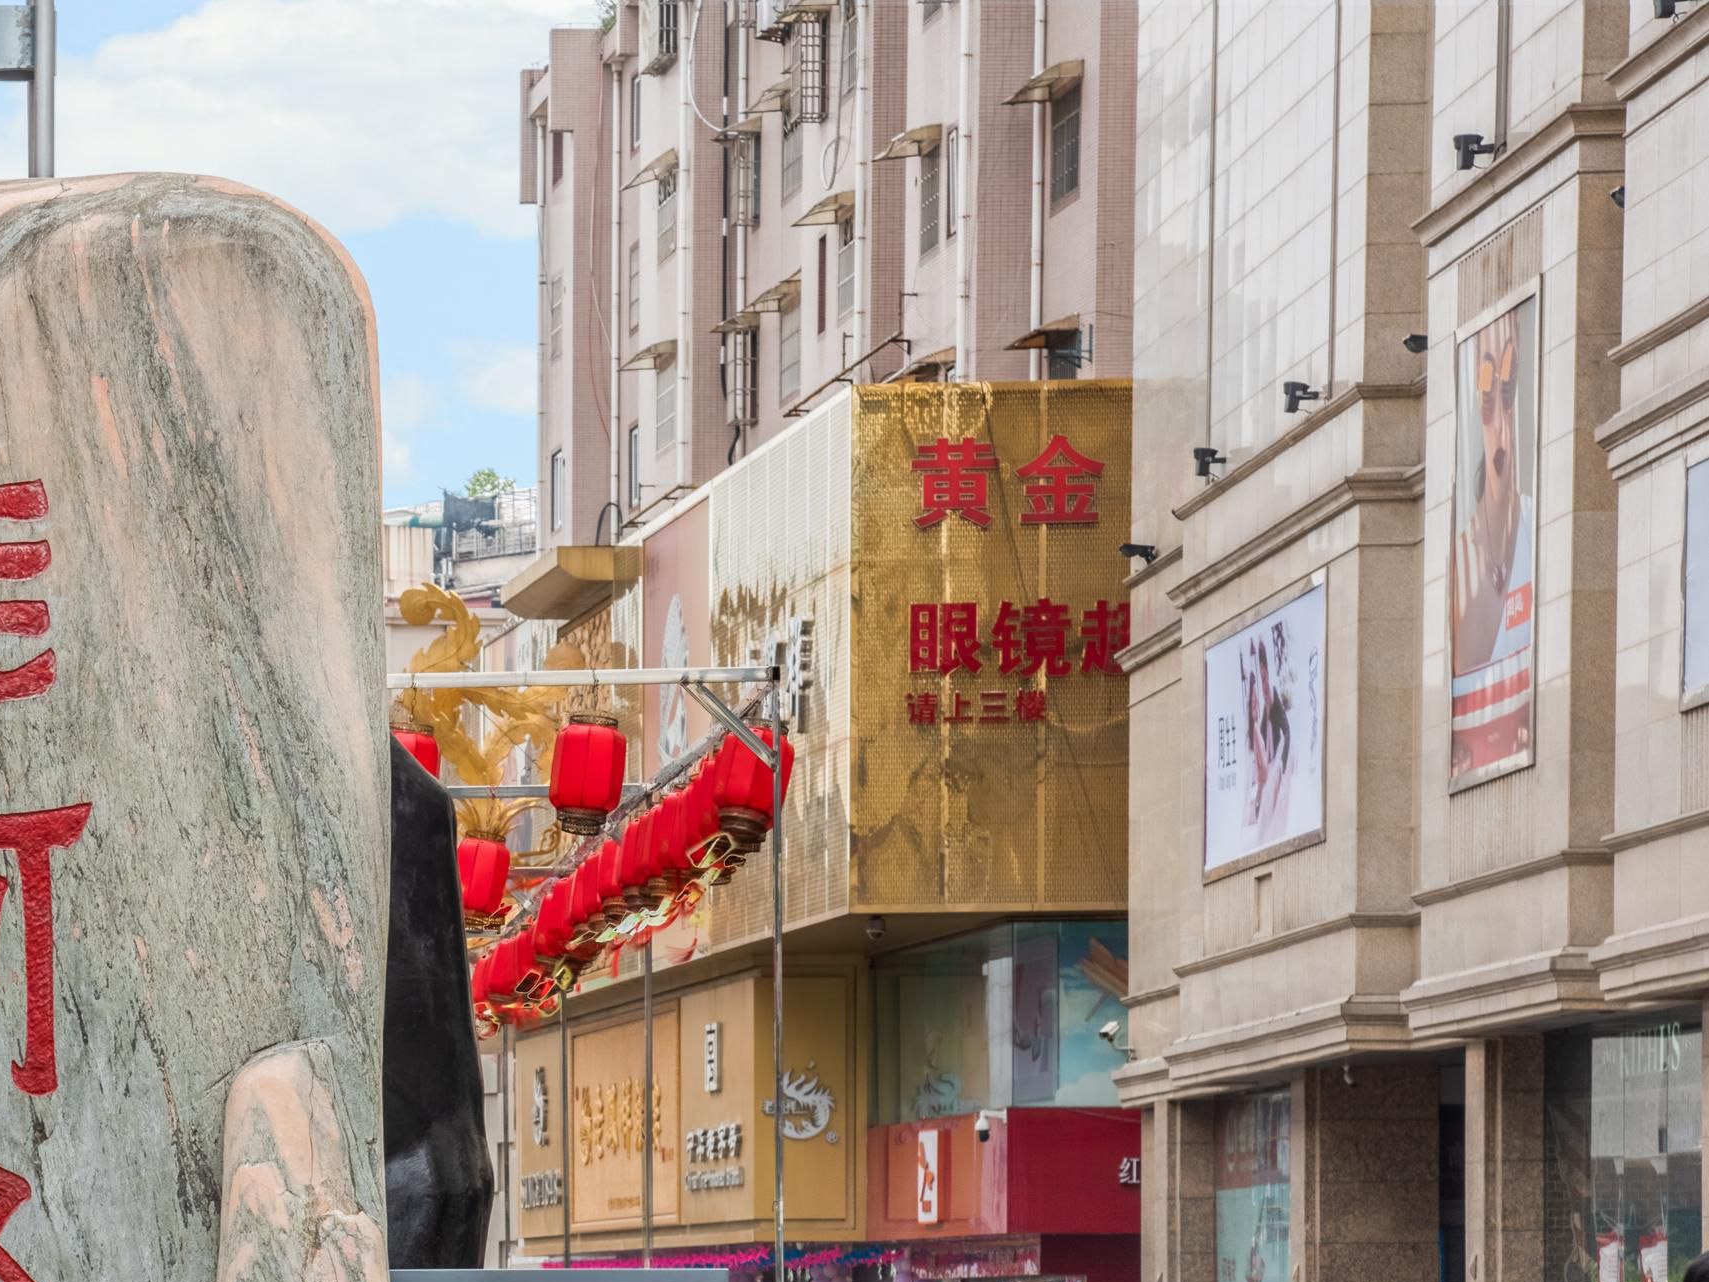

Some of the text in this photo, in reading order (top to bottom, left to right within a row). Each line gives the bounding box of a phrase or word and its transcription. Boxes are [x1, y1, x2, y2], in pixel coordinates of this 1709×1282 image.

[910, 435, 1106, 530] 黄金
[904, 689, 1047, 724] 请上三楼
[1118, 1157, 1140, 1184] 红
